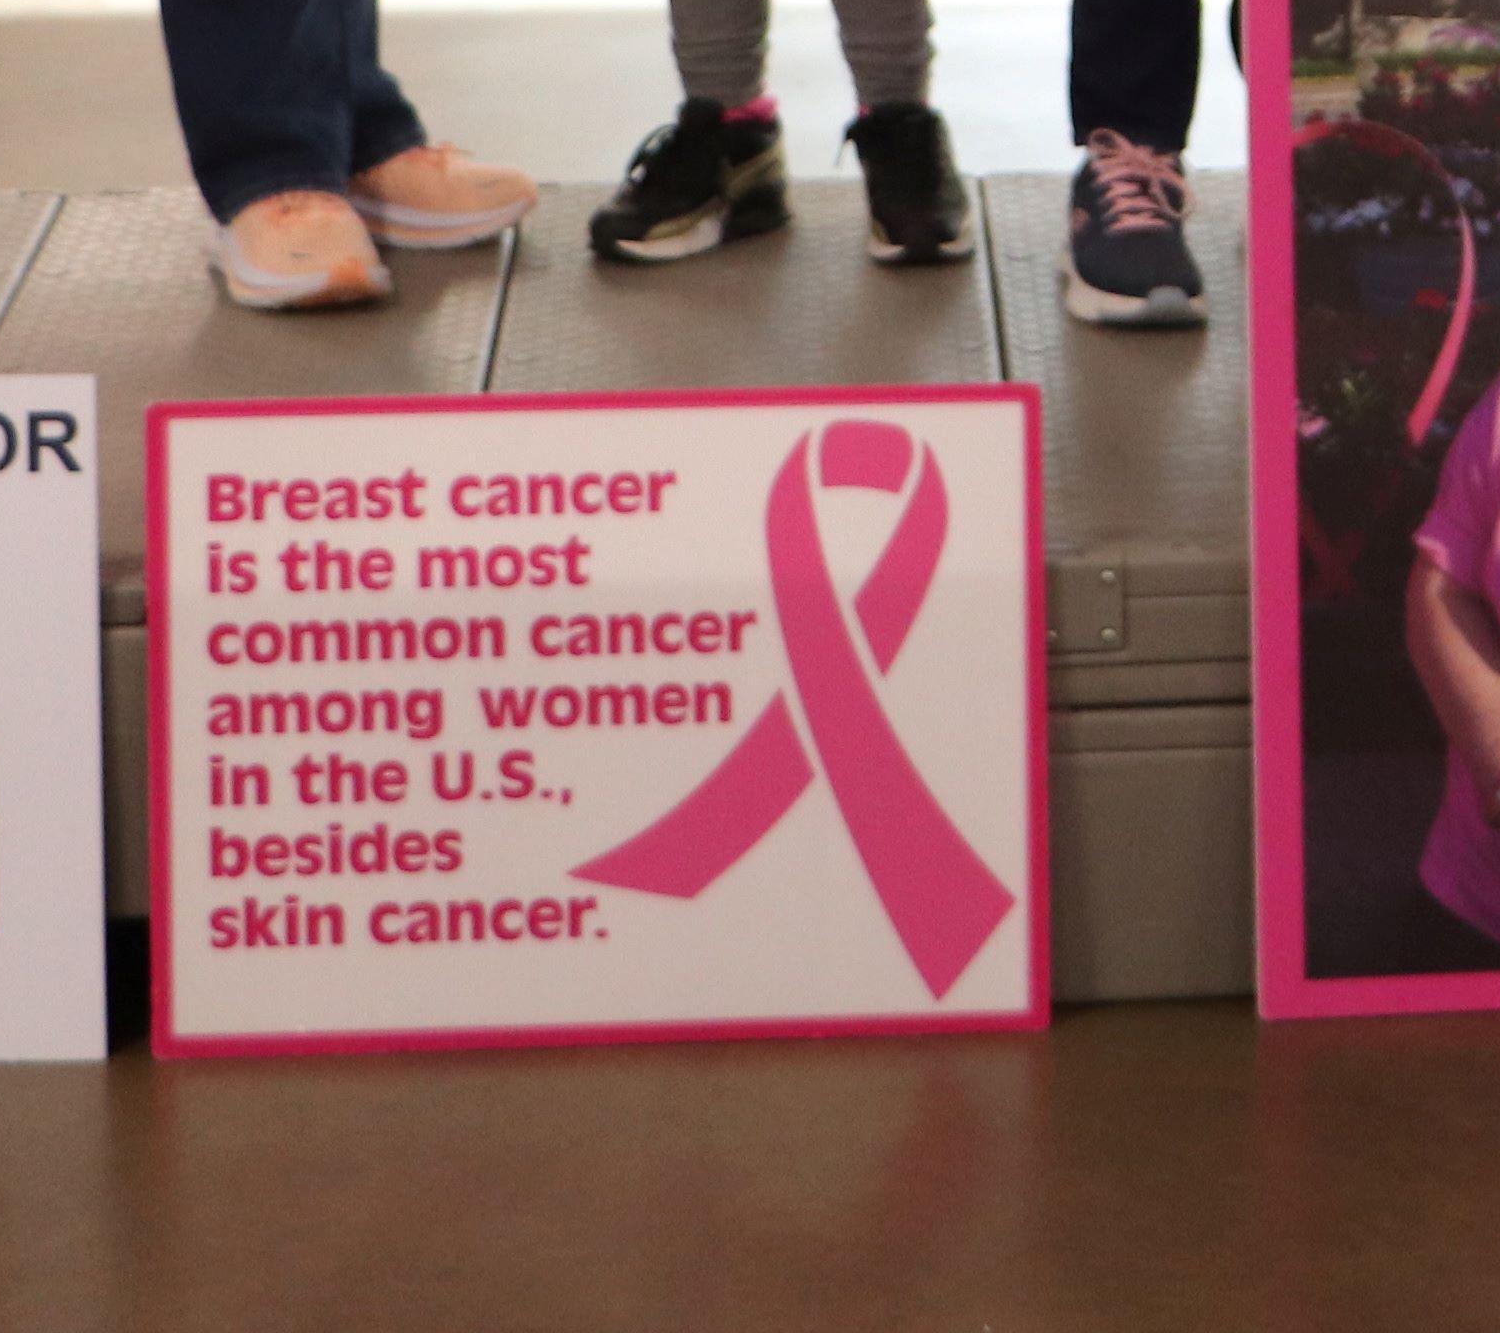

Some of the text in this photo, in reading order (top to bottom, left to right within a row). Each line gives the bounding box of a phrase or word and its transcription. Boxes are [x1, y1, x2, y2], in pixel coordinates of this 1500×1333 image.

[206, 469, 678, 524] Breast cancer
[206, 537, 591, 595] is the most
[206, 609, 758, 667] common cancer
[206, 681, 734, 742] among women
[208, 750, 575, 808] in the U.S.,
[208, 824, 464, 879] besides
[208, 893, 609, 952] skin cancer.
